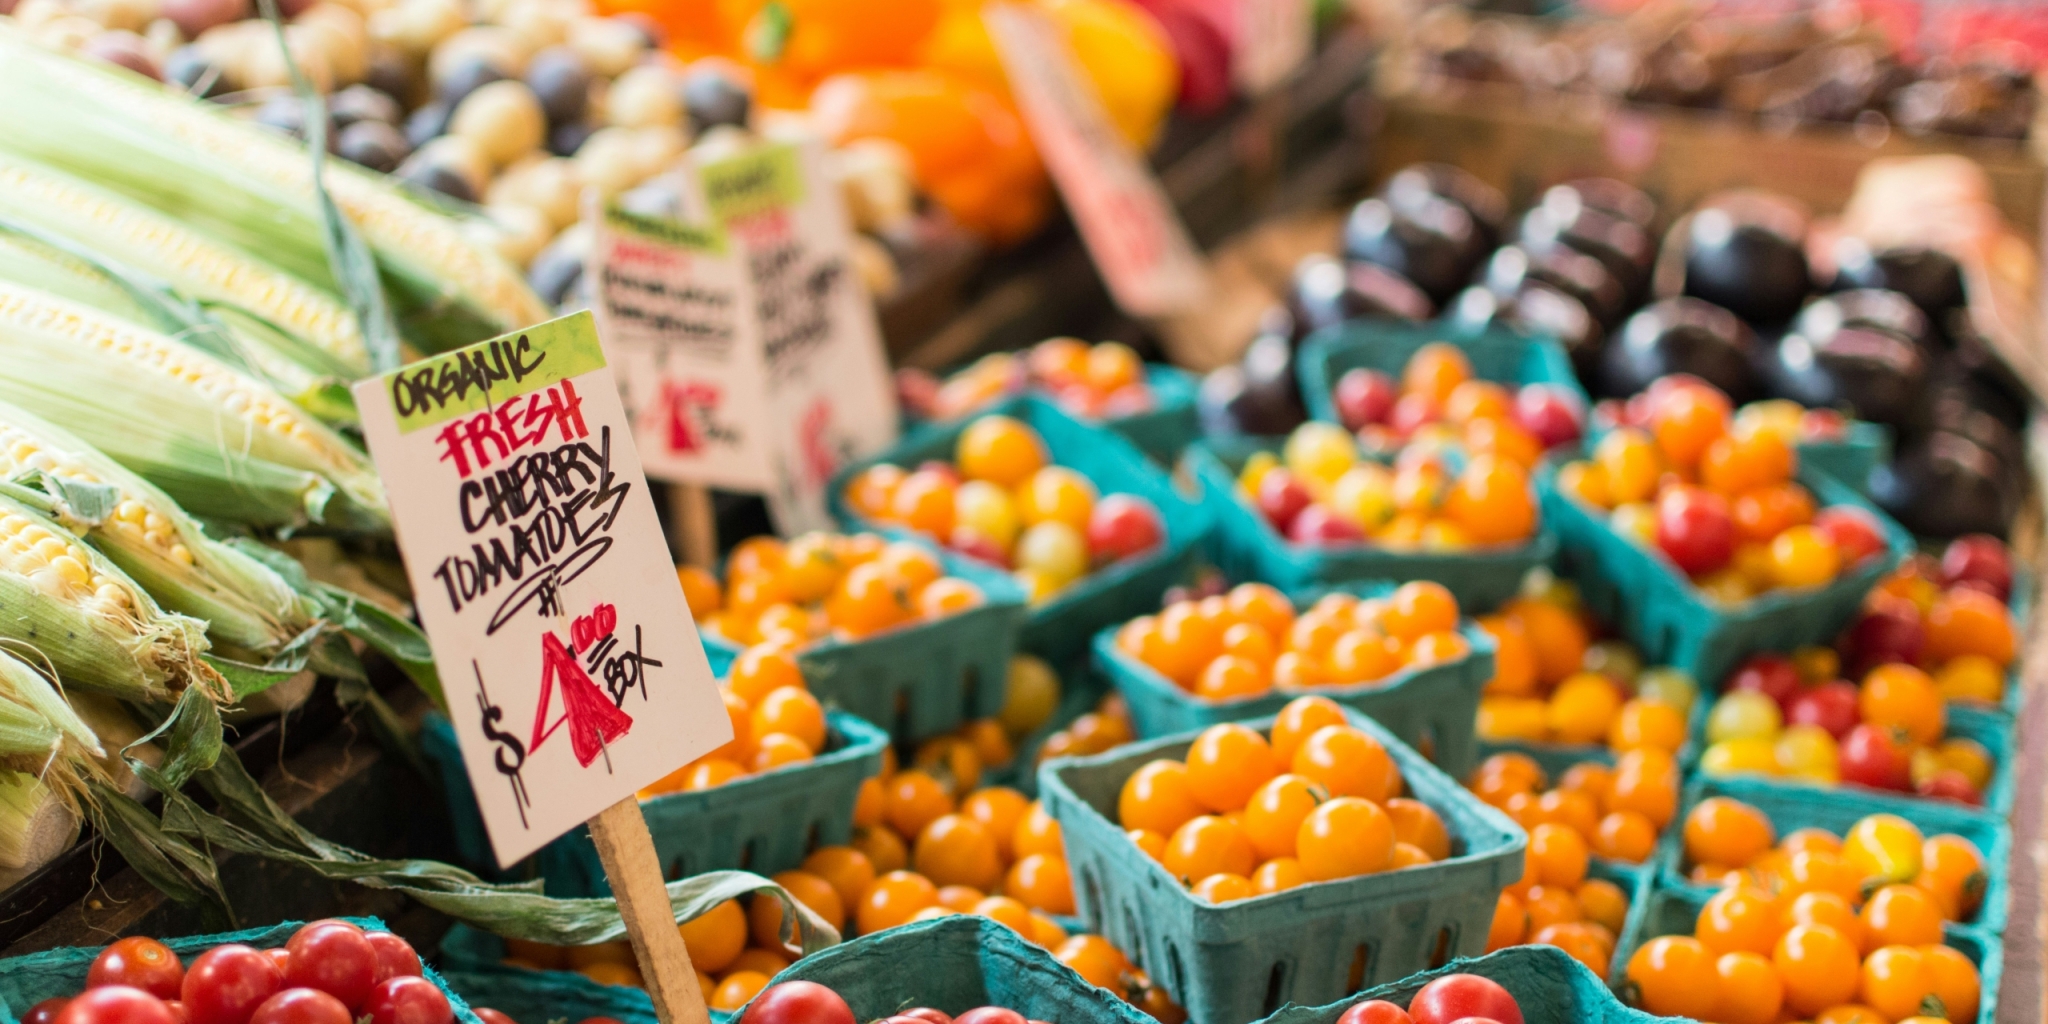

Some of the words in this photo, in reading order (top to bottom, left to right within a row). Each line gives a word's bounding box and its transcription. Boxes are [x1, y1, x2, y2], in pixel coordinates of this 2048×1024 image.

[392, 334, 546, 418] ORGANIC
[434, 378, 589, 479] FRESH
[460, 425, 611, 533] CHERRY
[433, 472, 632, 613] TOMATOES
[603, 623, 663, 708] BOX
